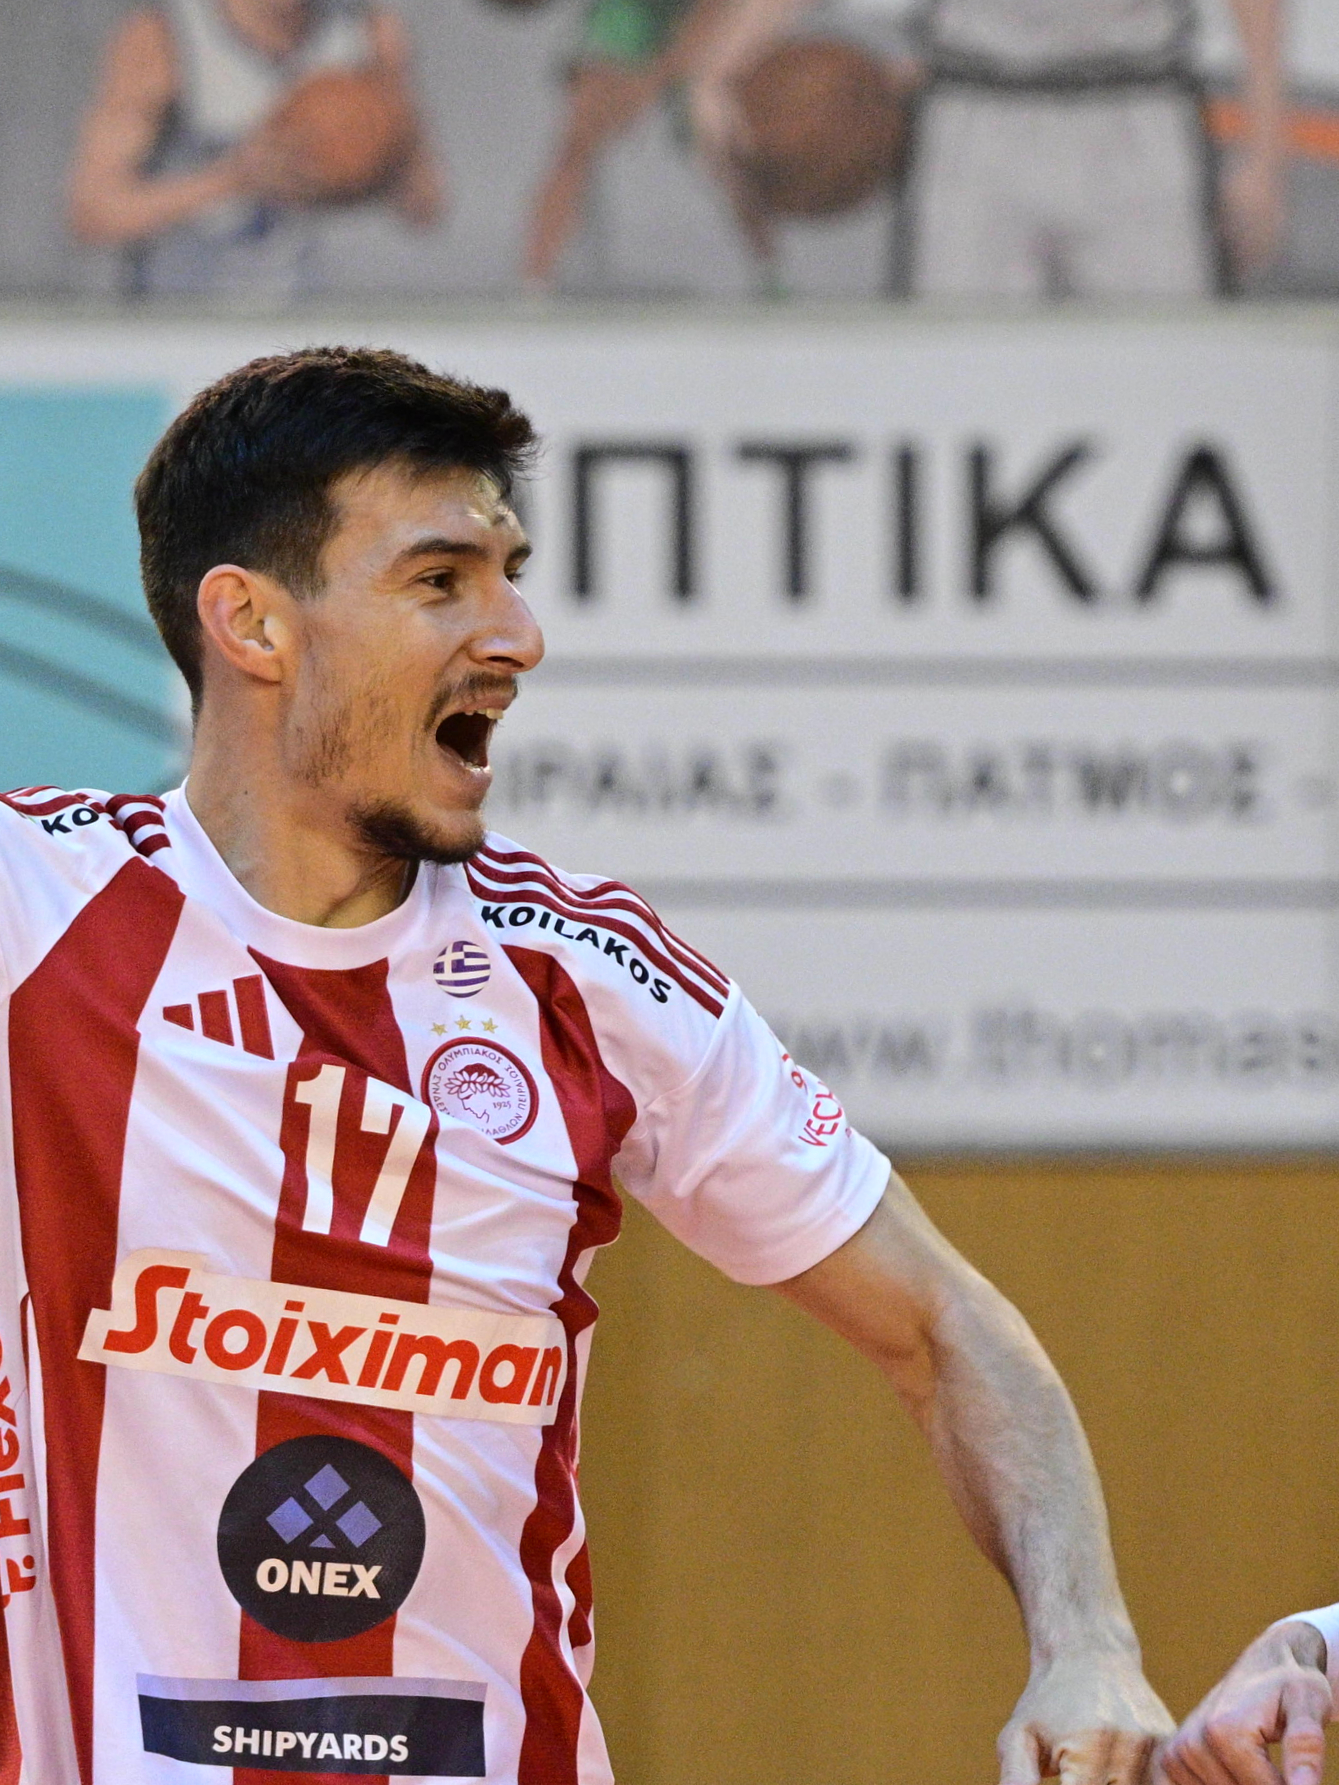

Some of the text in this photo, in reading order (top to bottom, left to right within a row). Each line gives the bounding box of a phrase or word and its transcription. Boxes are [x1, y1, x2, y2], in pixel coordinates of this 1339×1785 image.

[513, 435, 1286, 610] ΠΤΙΚΑ
[481, 904, 674, 1006] KOILAKOS
[437, 1047, 503, 1071] ΟΛΥΜΠΙΑΚΟΣ
[492, 1100, 512, 1111] 1925
[293, 1062, 430, 1248] 17
[102, 1263, 563, 1407] Stoiximan
[255, 1557, 382, 1600] ONEX
[211, 1723, 410, 1764] SHIPYARDS
